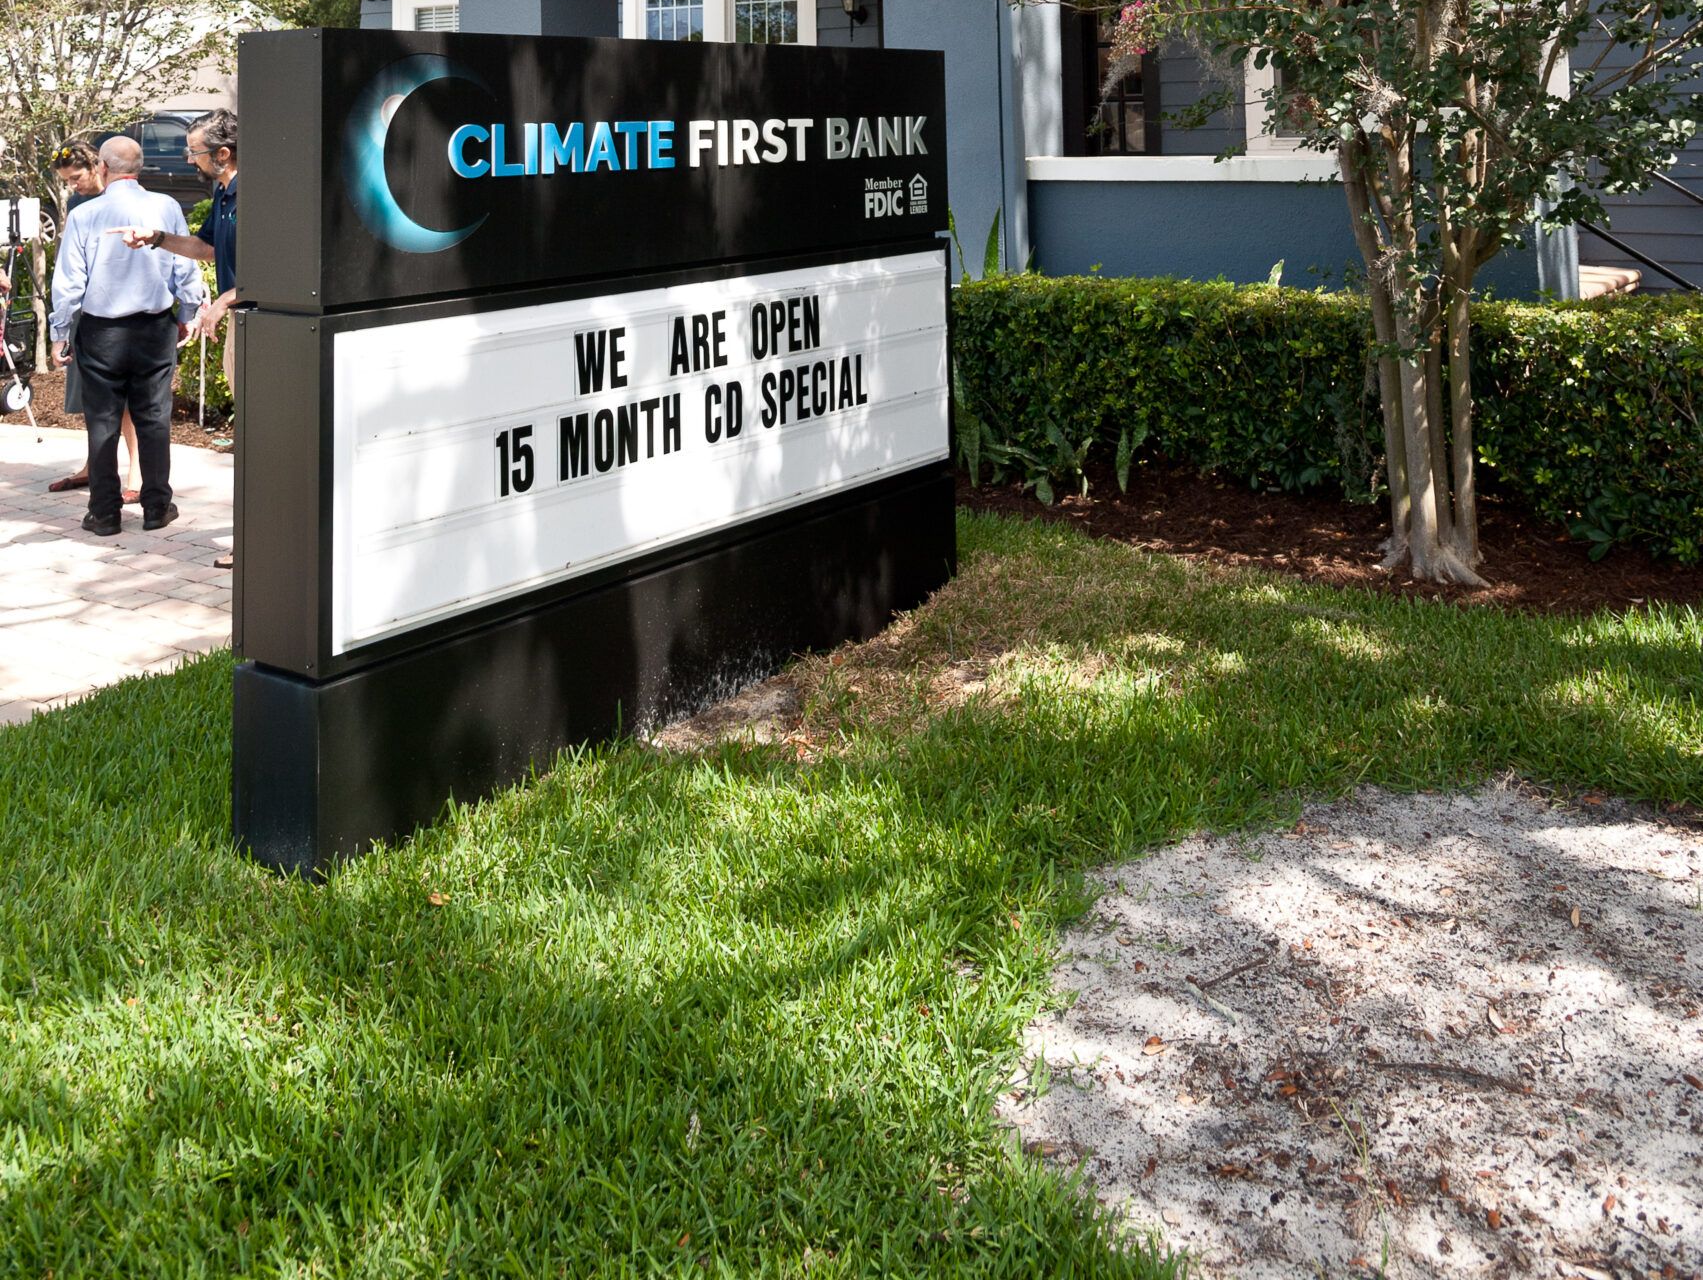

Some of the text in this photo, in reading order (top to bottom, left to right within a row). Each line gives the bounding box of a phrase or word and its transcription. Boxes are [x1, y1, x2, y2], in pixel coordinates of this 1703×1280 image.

[447, 115, 928, 178] CLIMATE FIRST BANK
[864, 176, 903, 191] Member
[864, 189, 903, 219] FDIC
[575, 294, 820, 396] WE ARE OPEN
[496, 353, 868, 497] 15 MONTH CD SPECIAL
